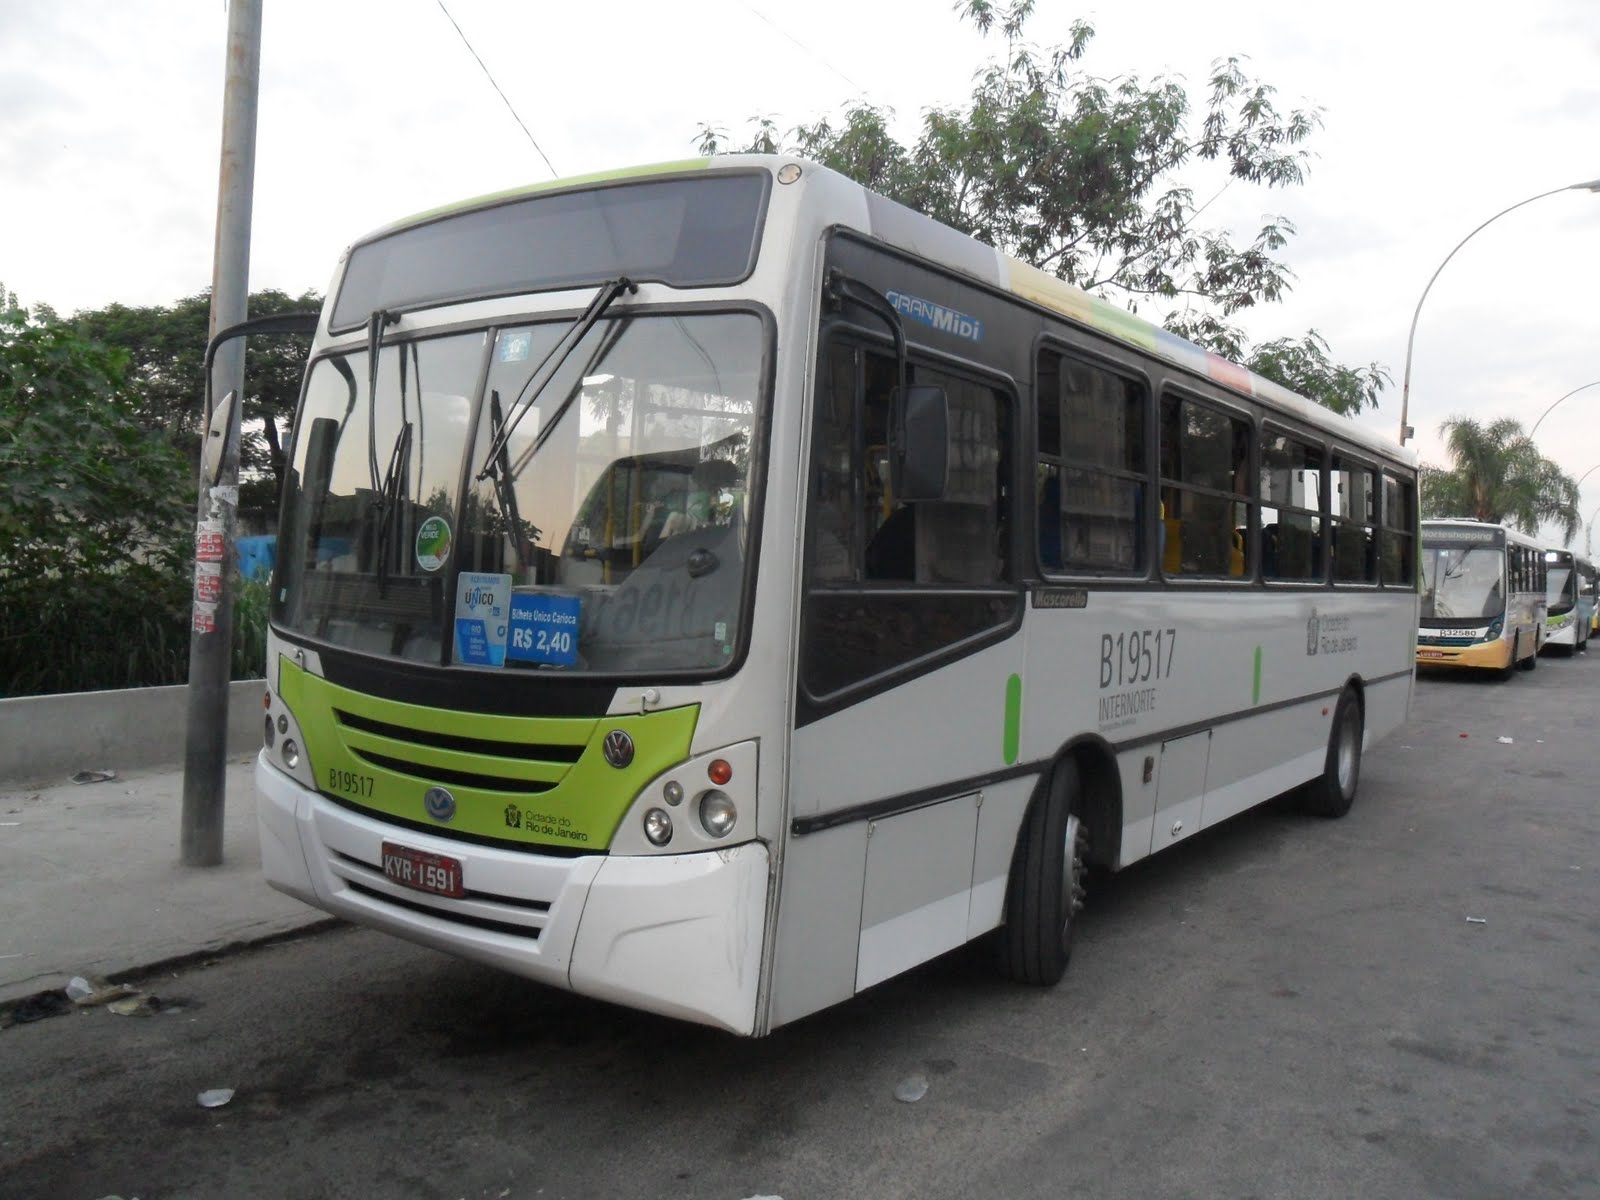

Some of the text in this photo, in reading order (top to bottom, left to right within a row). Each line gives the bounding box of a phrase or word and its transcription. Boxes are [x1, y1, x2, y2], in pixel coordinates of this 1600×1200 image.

[511, 608, 533, 621] Bilhete
[533, 607, 551, 623] Único
[552, 611, 577, 625] Carioca
[512, 627, 533, 652] R$
[536, 629, 571, 655] 2,40
[1100, 628, 1176, 688] B19517
[1098, 687, 1156, 720] INTERNORTE
[329, 768, 375, 797] B19517
[526, 810, 571, 827] Cidade do
[526, 821, 588, 841] Rio de Janeiro
